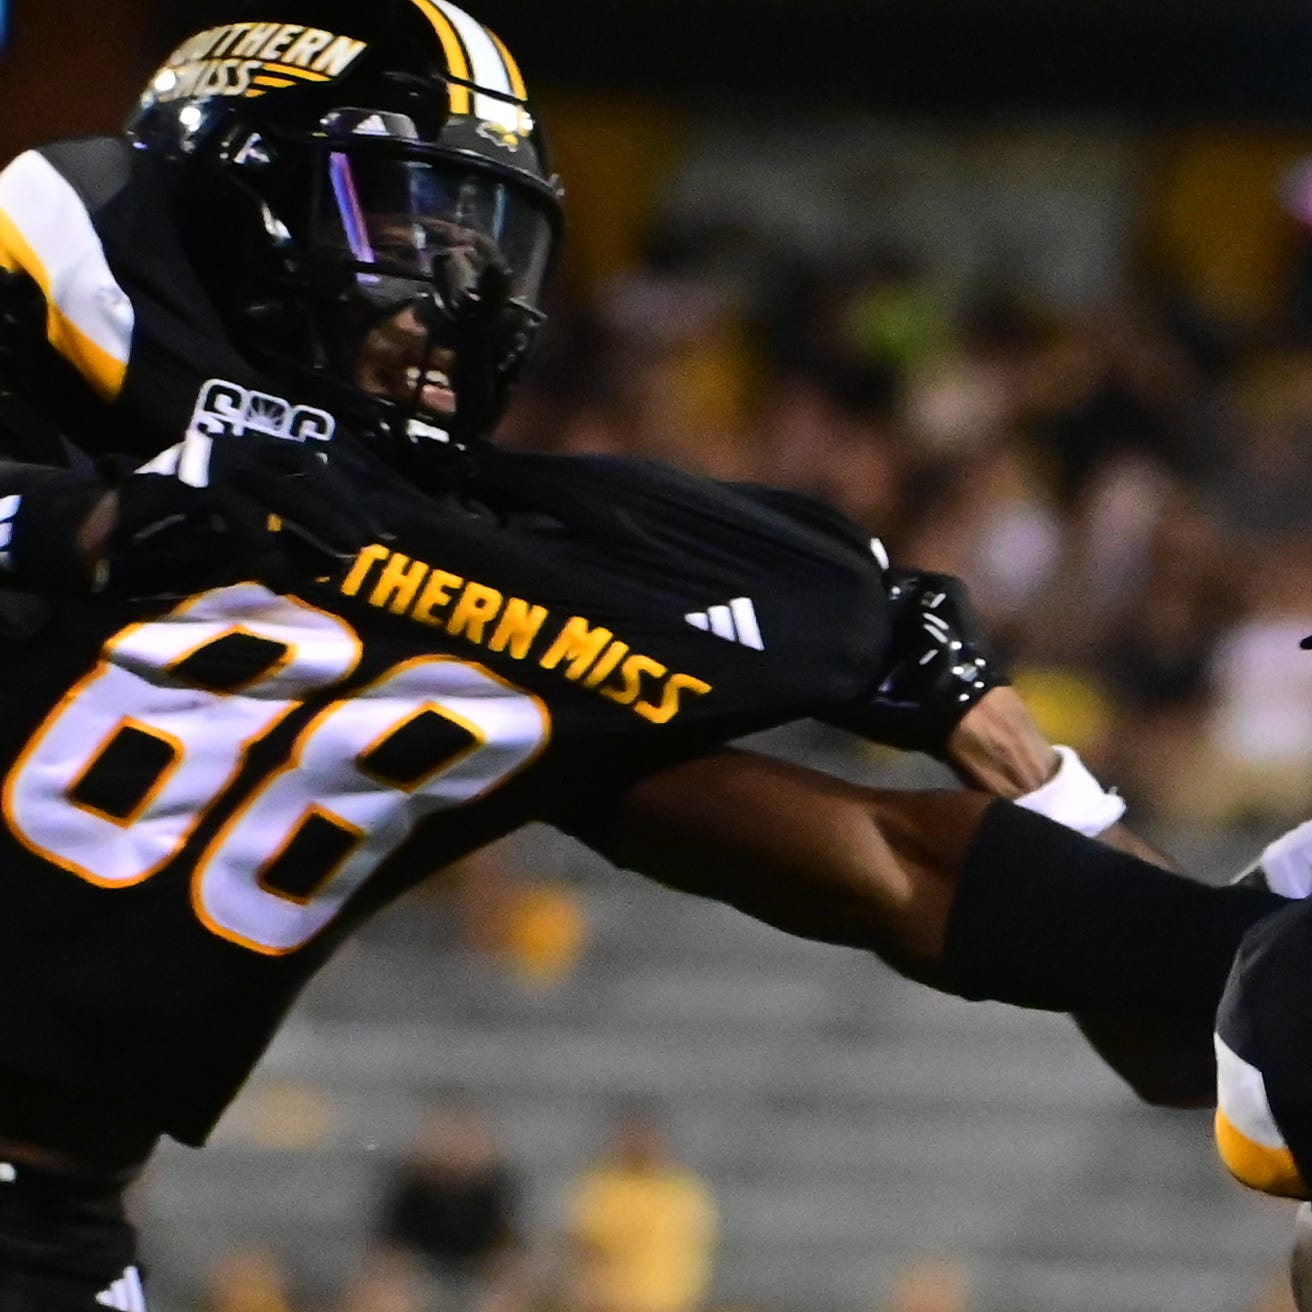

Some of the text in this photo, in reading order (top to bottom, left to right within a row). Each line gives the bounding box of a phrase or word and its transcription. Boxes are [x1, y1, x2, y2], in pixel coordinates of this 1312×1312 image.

[2, 579, 553, 956] 88
[338, 543, 714, 725] THERN MISS
